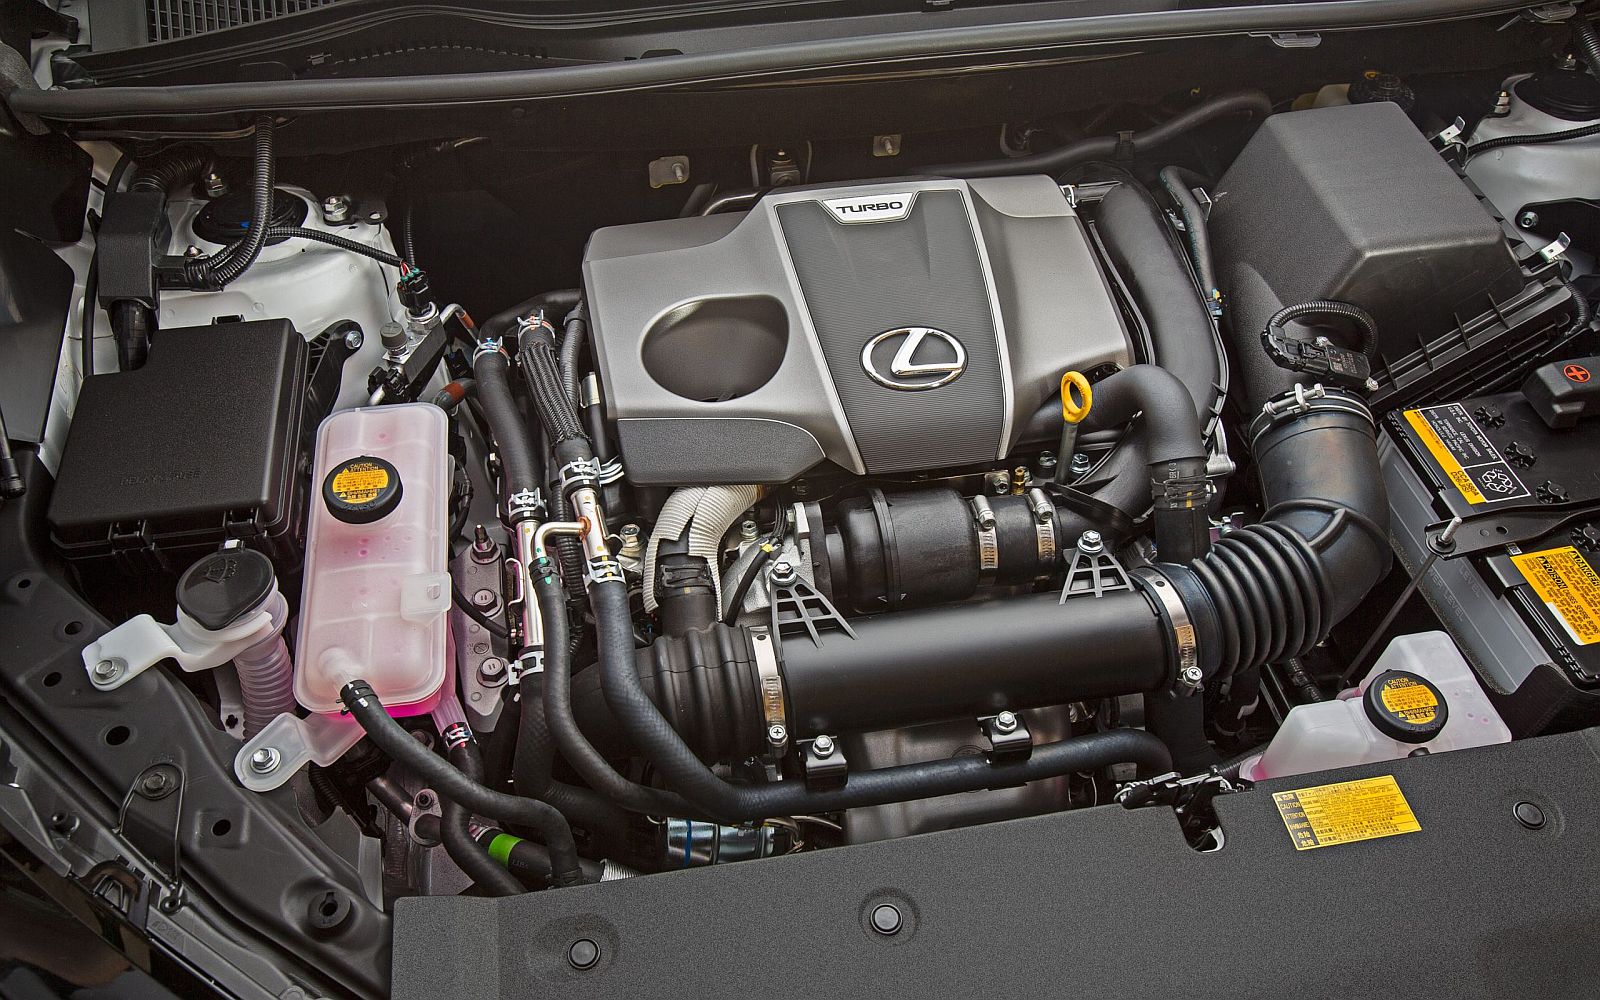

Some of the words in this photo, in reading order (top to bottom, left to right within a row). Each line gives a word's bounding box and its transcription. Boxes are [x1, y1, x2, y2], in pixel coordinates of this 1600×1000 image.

[836, 201, 903, 214] TURBO
[1541, 563, 1567, 588] POISON
[1573, 557, 1600, 585] DANGER
